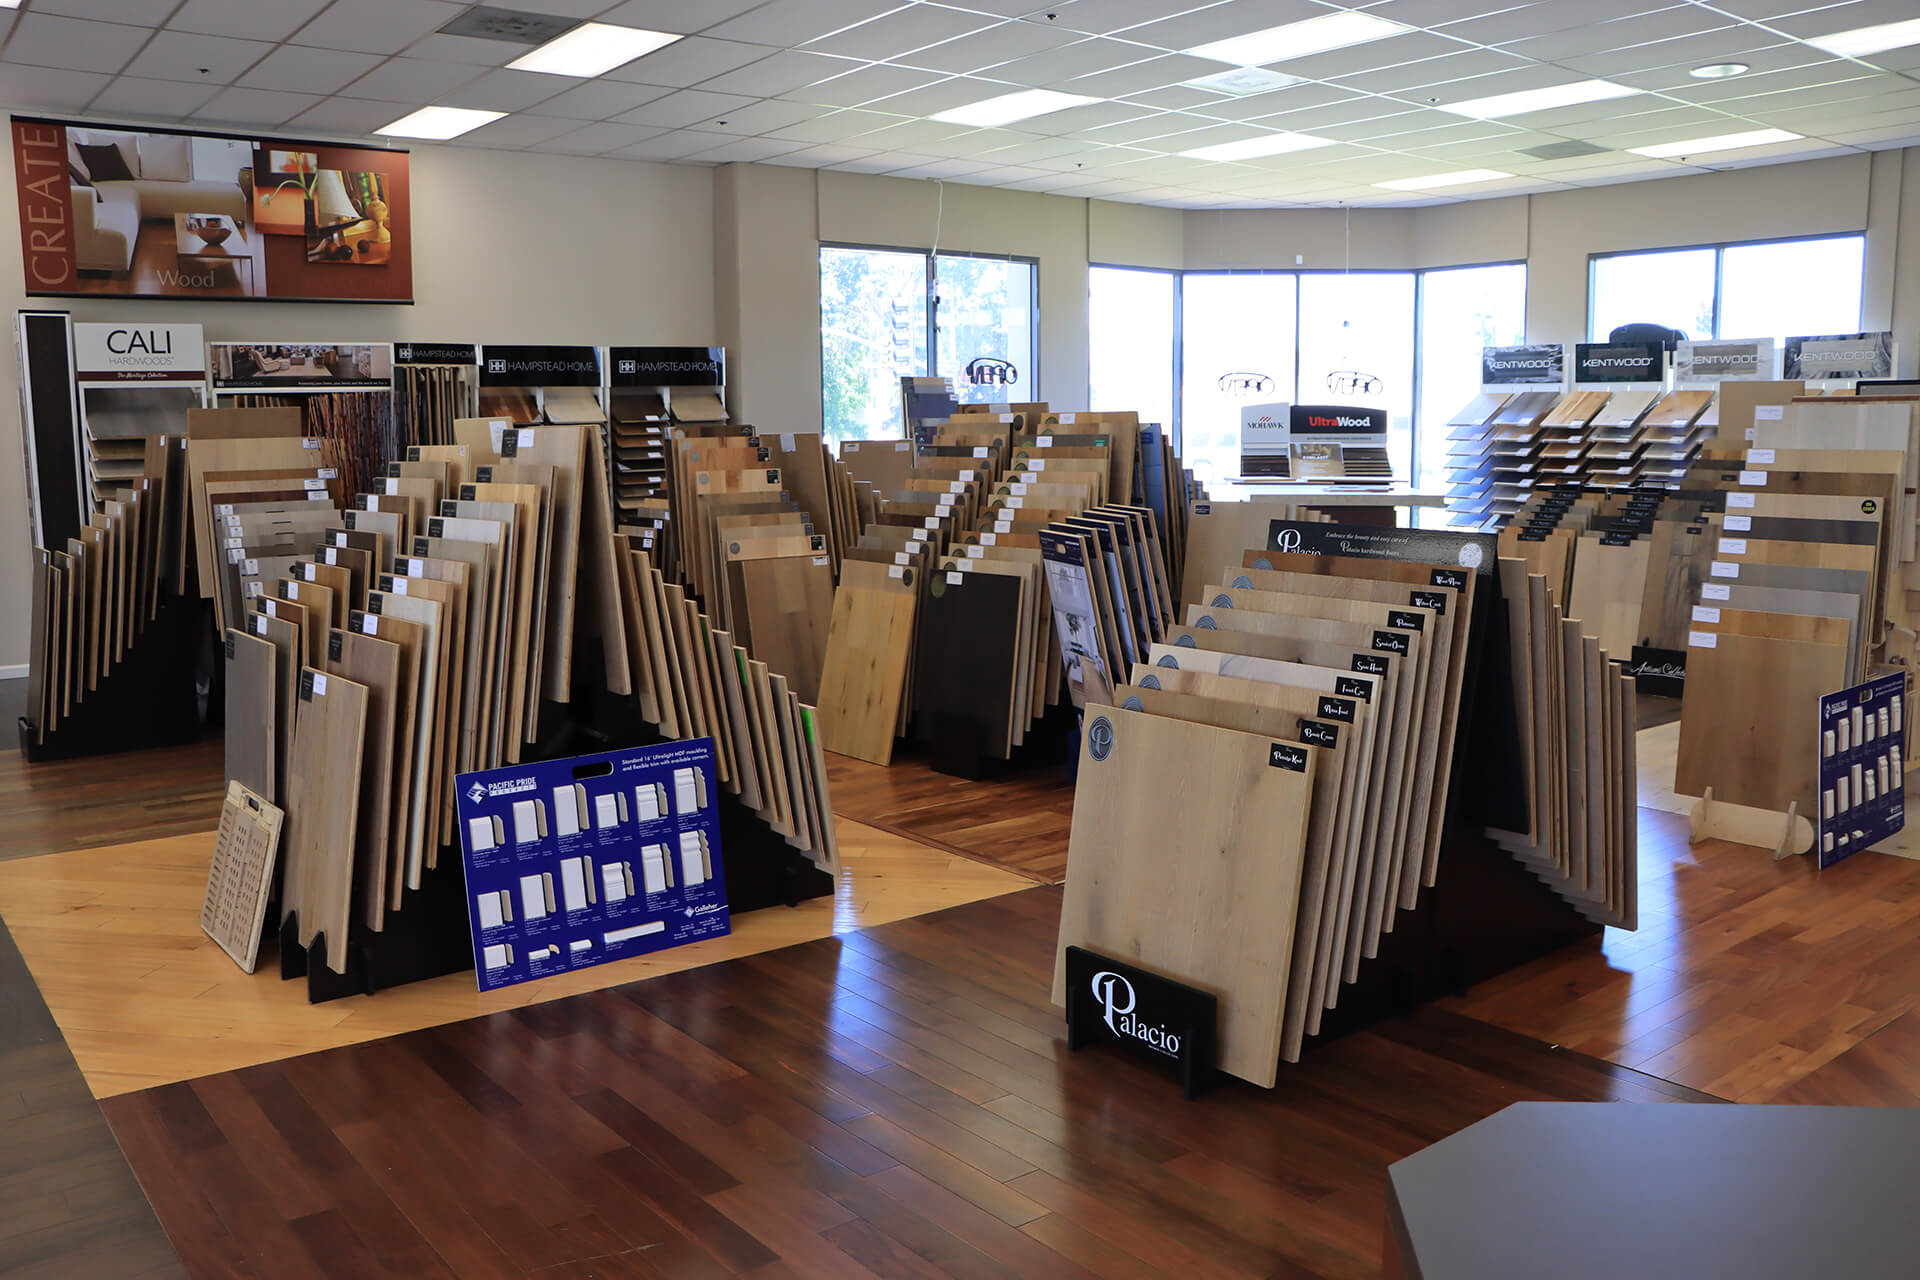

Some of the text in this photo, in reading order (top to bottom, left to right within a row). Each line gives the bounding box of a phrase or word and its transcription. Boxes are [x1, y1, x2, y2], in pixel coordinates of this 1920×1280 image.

[20, 127, 69, 285] CREATE
[156, 269, 215, 288] Wood
[107, 329, 171, 354] CALI
[1793, 350, 1877, 362] KENTWOOD
[507, 361, 566, 372] HAMPSTEAD
[567, 361, 593, 372] HOME
[637, 361, 691, 372] HAMPSTEAD
[692, 361, 716, 372] HOME
[1489, 359, 1551, 369] KENTWOOD
[1583, 357, 1653, 368] KENTWOOD
[1247, 421, 1285, 430] MOHAWK
[1308, 415, 1371, 428] UltraWood
[488, 780, 515, 792] PACIFIC
[515, 776, 536, 787] PRIDE
[1091, 970, 1181, 1054] Palacio
